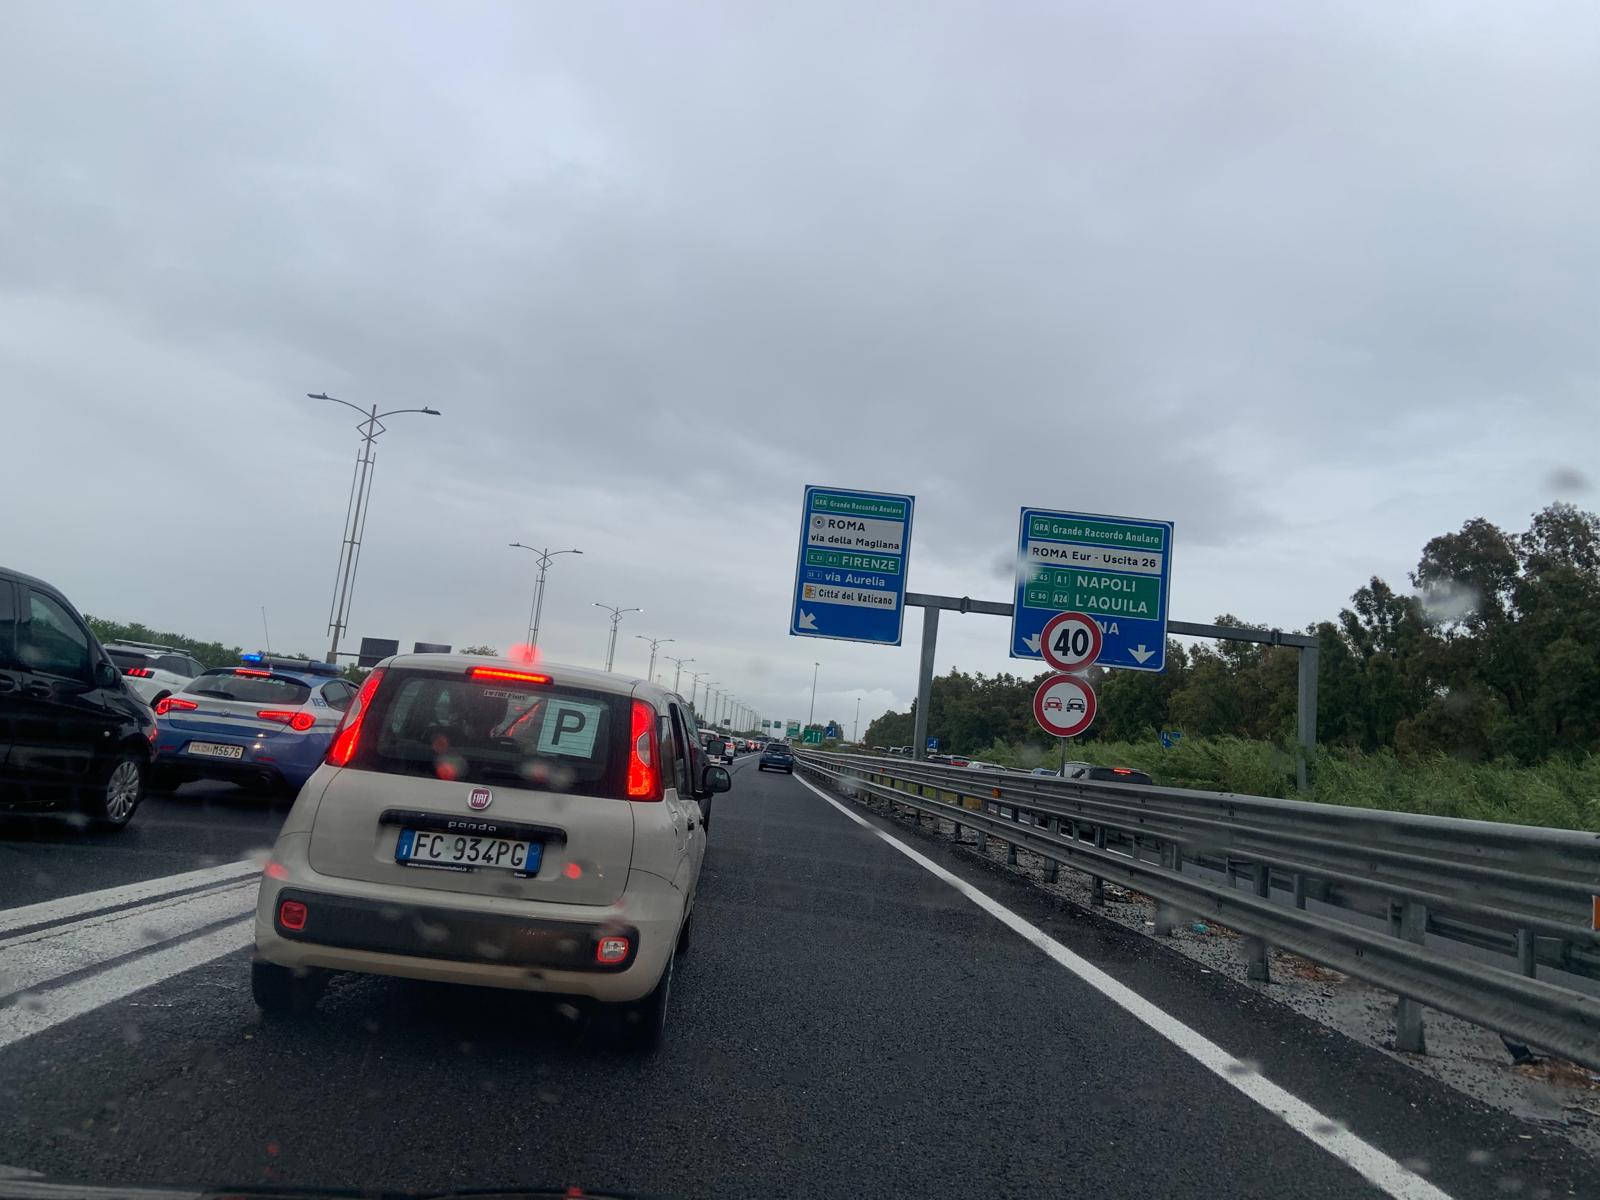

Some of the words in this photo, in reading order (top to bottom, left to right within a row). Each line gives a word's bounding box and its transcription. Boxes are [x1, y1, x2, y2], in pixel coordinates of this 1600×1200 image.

[830, 500, 850, 509] Grande
[852, 503, 877, 512] Raccordo
[879, 506, 903, 515] Anulare
[828, 519, 866, 532] ROMA
[1034, 522, 1049, 533] GRA
[1052, 524, 1083, 537] Grande
[1085, 527, 1123, 540] Raccordo
[1126, 531, 1159, 544] Anulare
[811, 534, 825, 542] via
[828, 536, 852, 545] della
[856, 538, 900, 550] Magliana
[842, 556, 896, 570] FIRENZE
[1032, 547, 1068, 560] ROMA
[1072, 551, 1091, 562] Eur
[1103, 554, 1138, 567] Uscita
[1141, 558, 1157, 568] 26
[825, 572, 841, 582] via
[845, 574, 886, 587] Aurelia
[1077, 575, 1136, 592] NAPOLI
[842, 591, 854, 600] del
[857, 593, 893, 605] Vaticano
[1053, 594, 1068, 603] A24
[1075, 592, 1148, 613] L'AQUILA
[1053, 628, 1089, 657] 40
[551, 708, 586, 746] P
[212, 745, 241, 757] M5676
[472, 793, 488, 804] FIAT
[413, 833, 444, 858] FC
